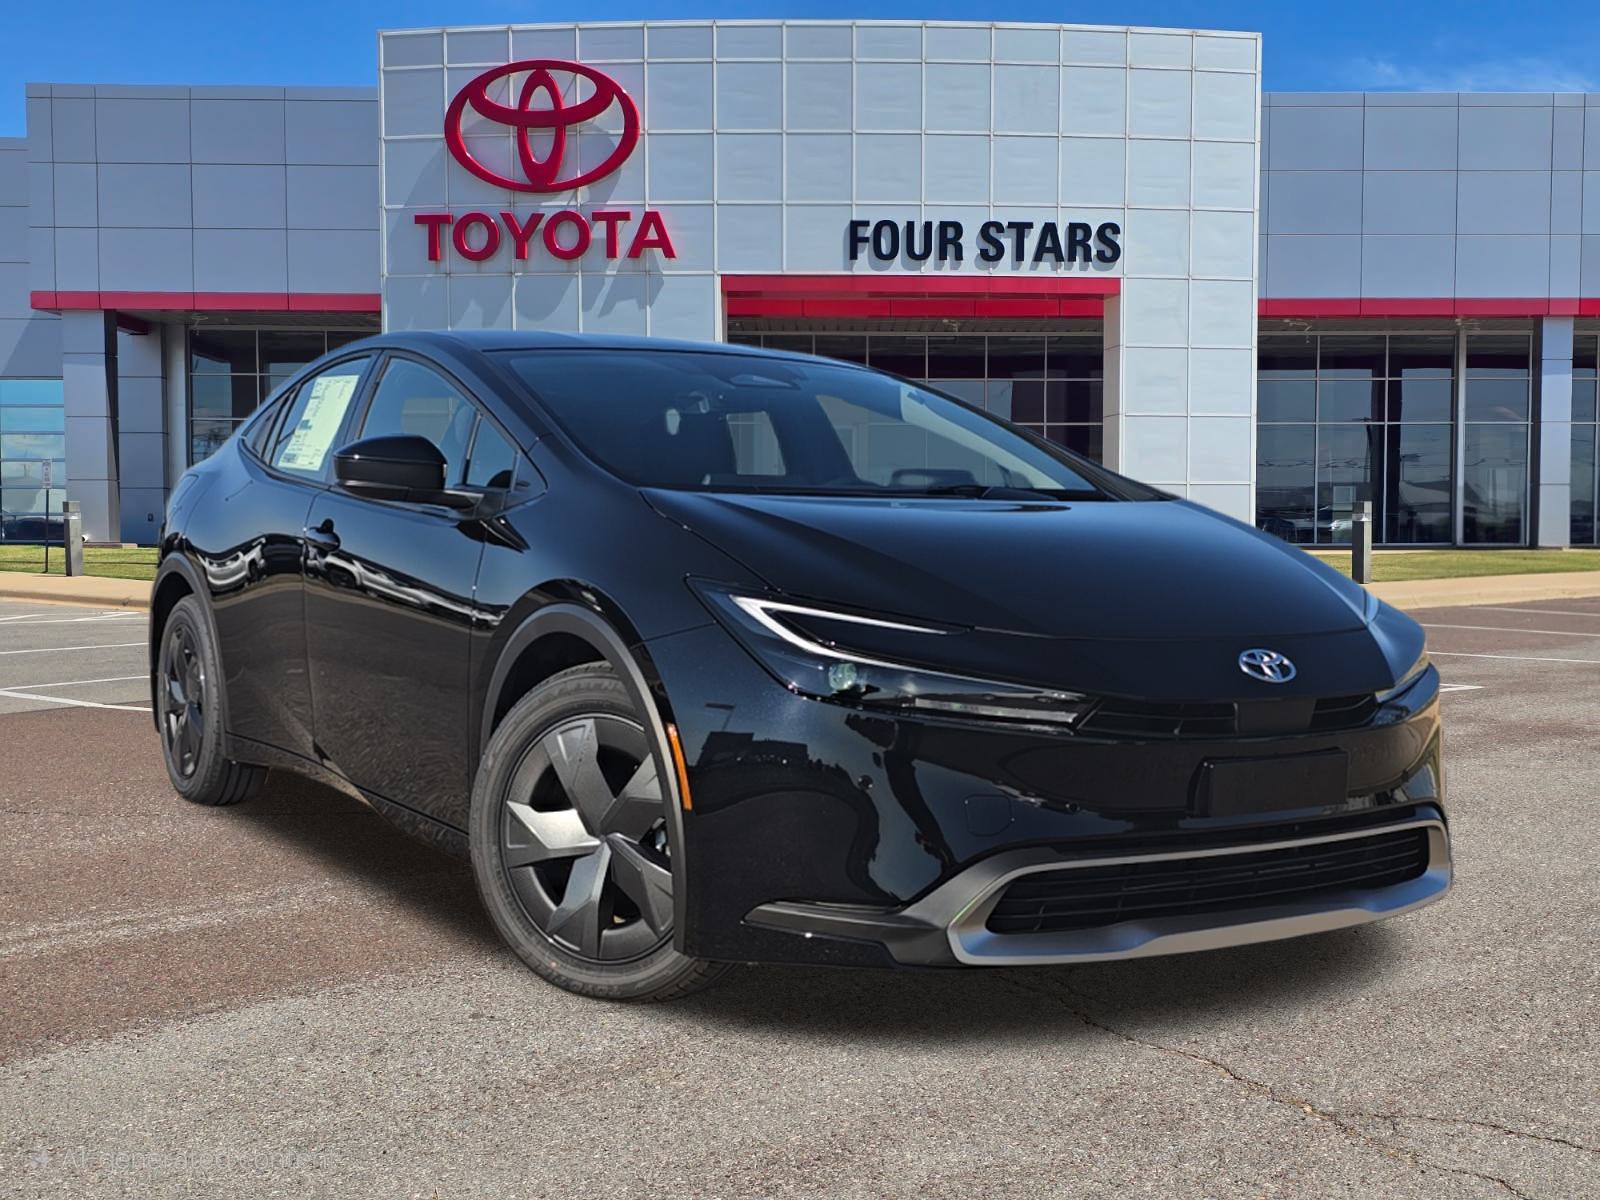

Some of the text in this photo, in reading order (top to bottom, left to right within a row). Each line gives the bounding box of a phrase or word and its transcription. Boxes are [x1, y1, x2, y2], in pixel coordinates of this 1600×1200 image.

[414, 210, 677, 262] TOYOTA
[849, 219, 1122, 264] FOUR STARS
